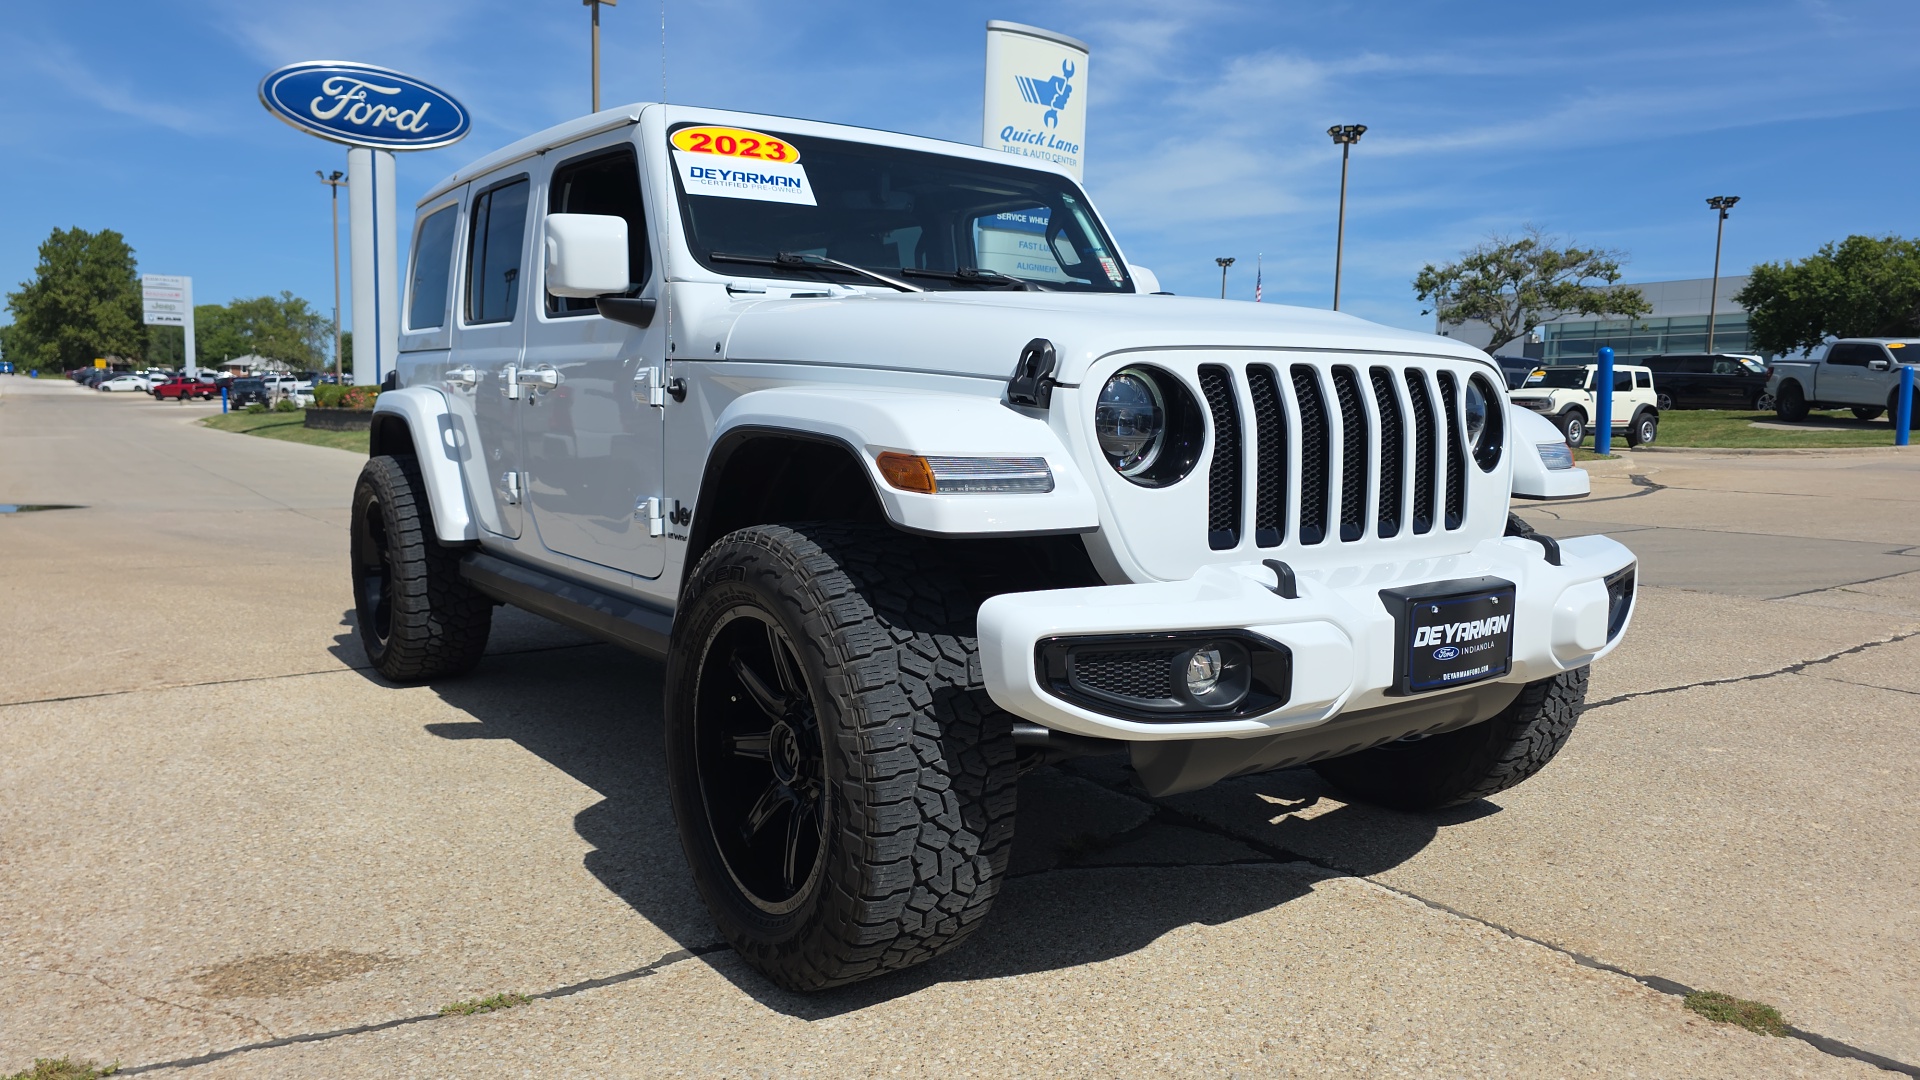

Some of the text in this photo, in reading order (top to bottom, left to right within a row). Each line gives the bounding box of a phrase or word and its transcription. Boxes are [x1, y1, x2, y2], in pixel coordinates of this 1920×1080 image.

[310, 76, 431, 133] Ford
[689, 133, 787, 161] 2023
[1000, 125, 1079, 155] Quick Lane
[1003, 145, 1077, 167] TIRE & AUTO CENTER
[690, 166, 801, 188] DEYARMAN
[700, 179, 803, 194] CERTIFIED PRE-OWNED
[997, 212, 1049, 226] SERVICE WHILE
[1019, 240, 1037, 251] FAST
[1016, 262, 1058, 274] ALIGNMENT
[1413, 613, 1511, 648] DEYARMAN
[1461, 641, 1495, 655] INDIANOLA
[1443, 665, 1489, 680] DEYARMANFORD.COM
